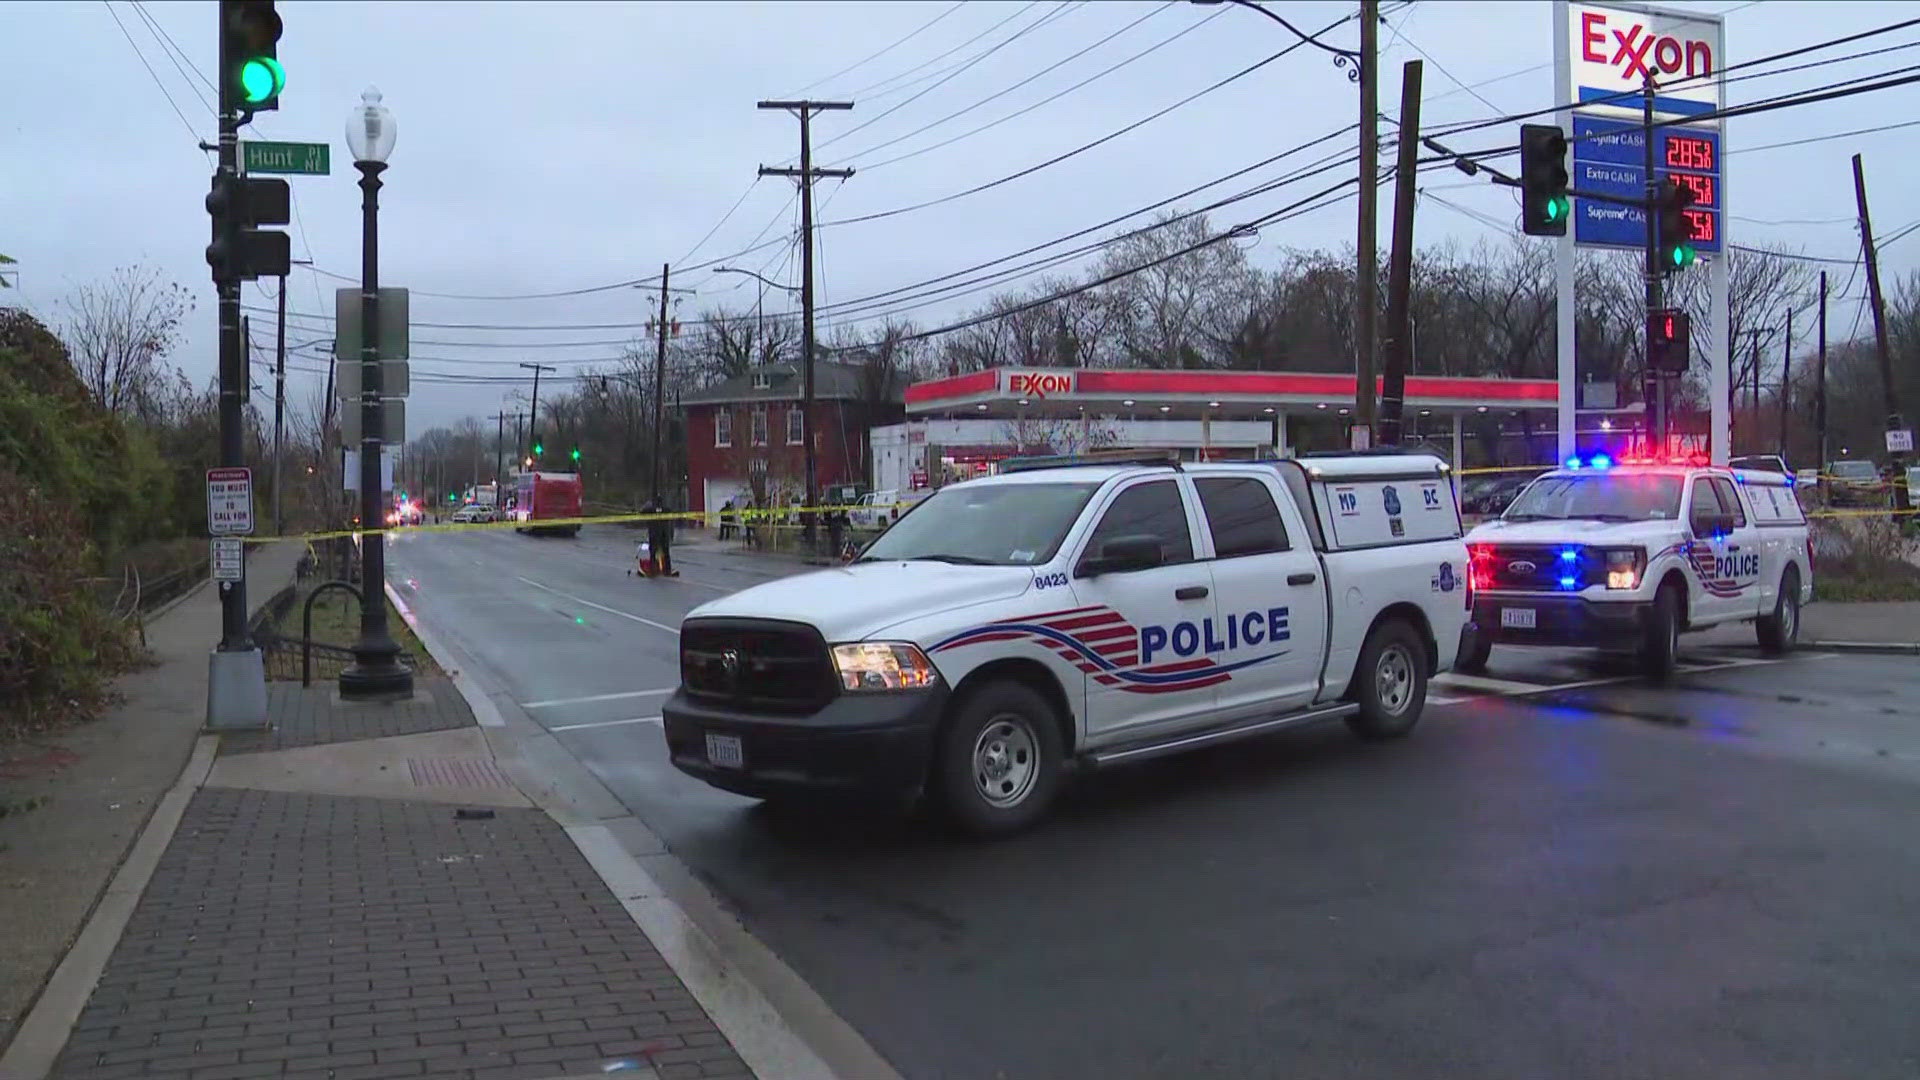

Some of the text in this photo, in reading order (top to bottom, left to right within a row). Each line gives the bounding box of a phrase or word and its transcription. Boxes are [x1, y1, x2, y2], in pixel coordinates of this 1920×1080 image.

[1582, 12, 1711, 79] Exxon
[1621, 134, 1646, 147] CASH
[250, 147, 294, 167] Hunt
[309, 145, 320, 159] Pl
[305, 160, 320, 173] NE
[1586, 167, 1637, 184] Extra CASH
[1010, 372, 1070, 399] EXXON
[211, 482, 247, 493] YOU MUST
[1338, 493, 1357, 511] MP
[1423, 489, 1439, 505] DC
[1716, 554, 1759, 579] POLICE
[1035, 572, 1069, 590] 8423
[1141, 607, 1291, 664] POLICE
